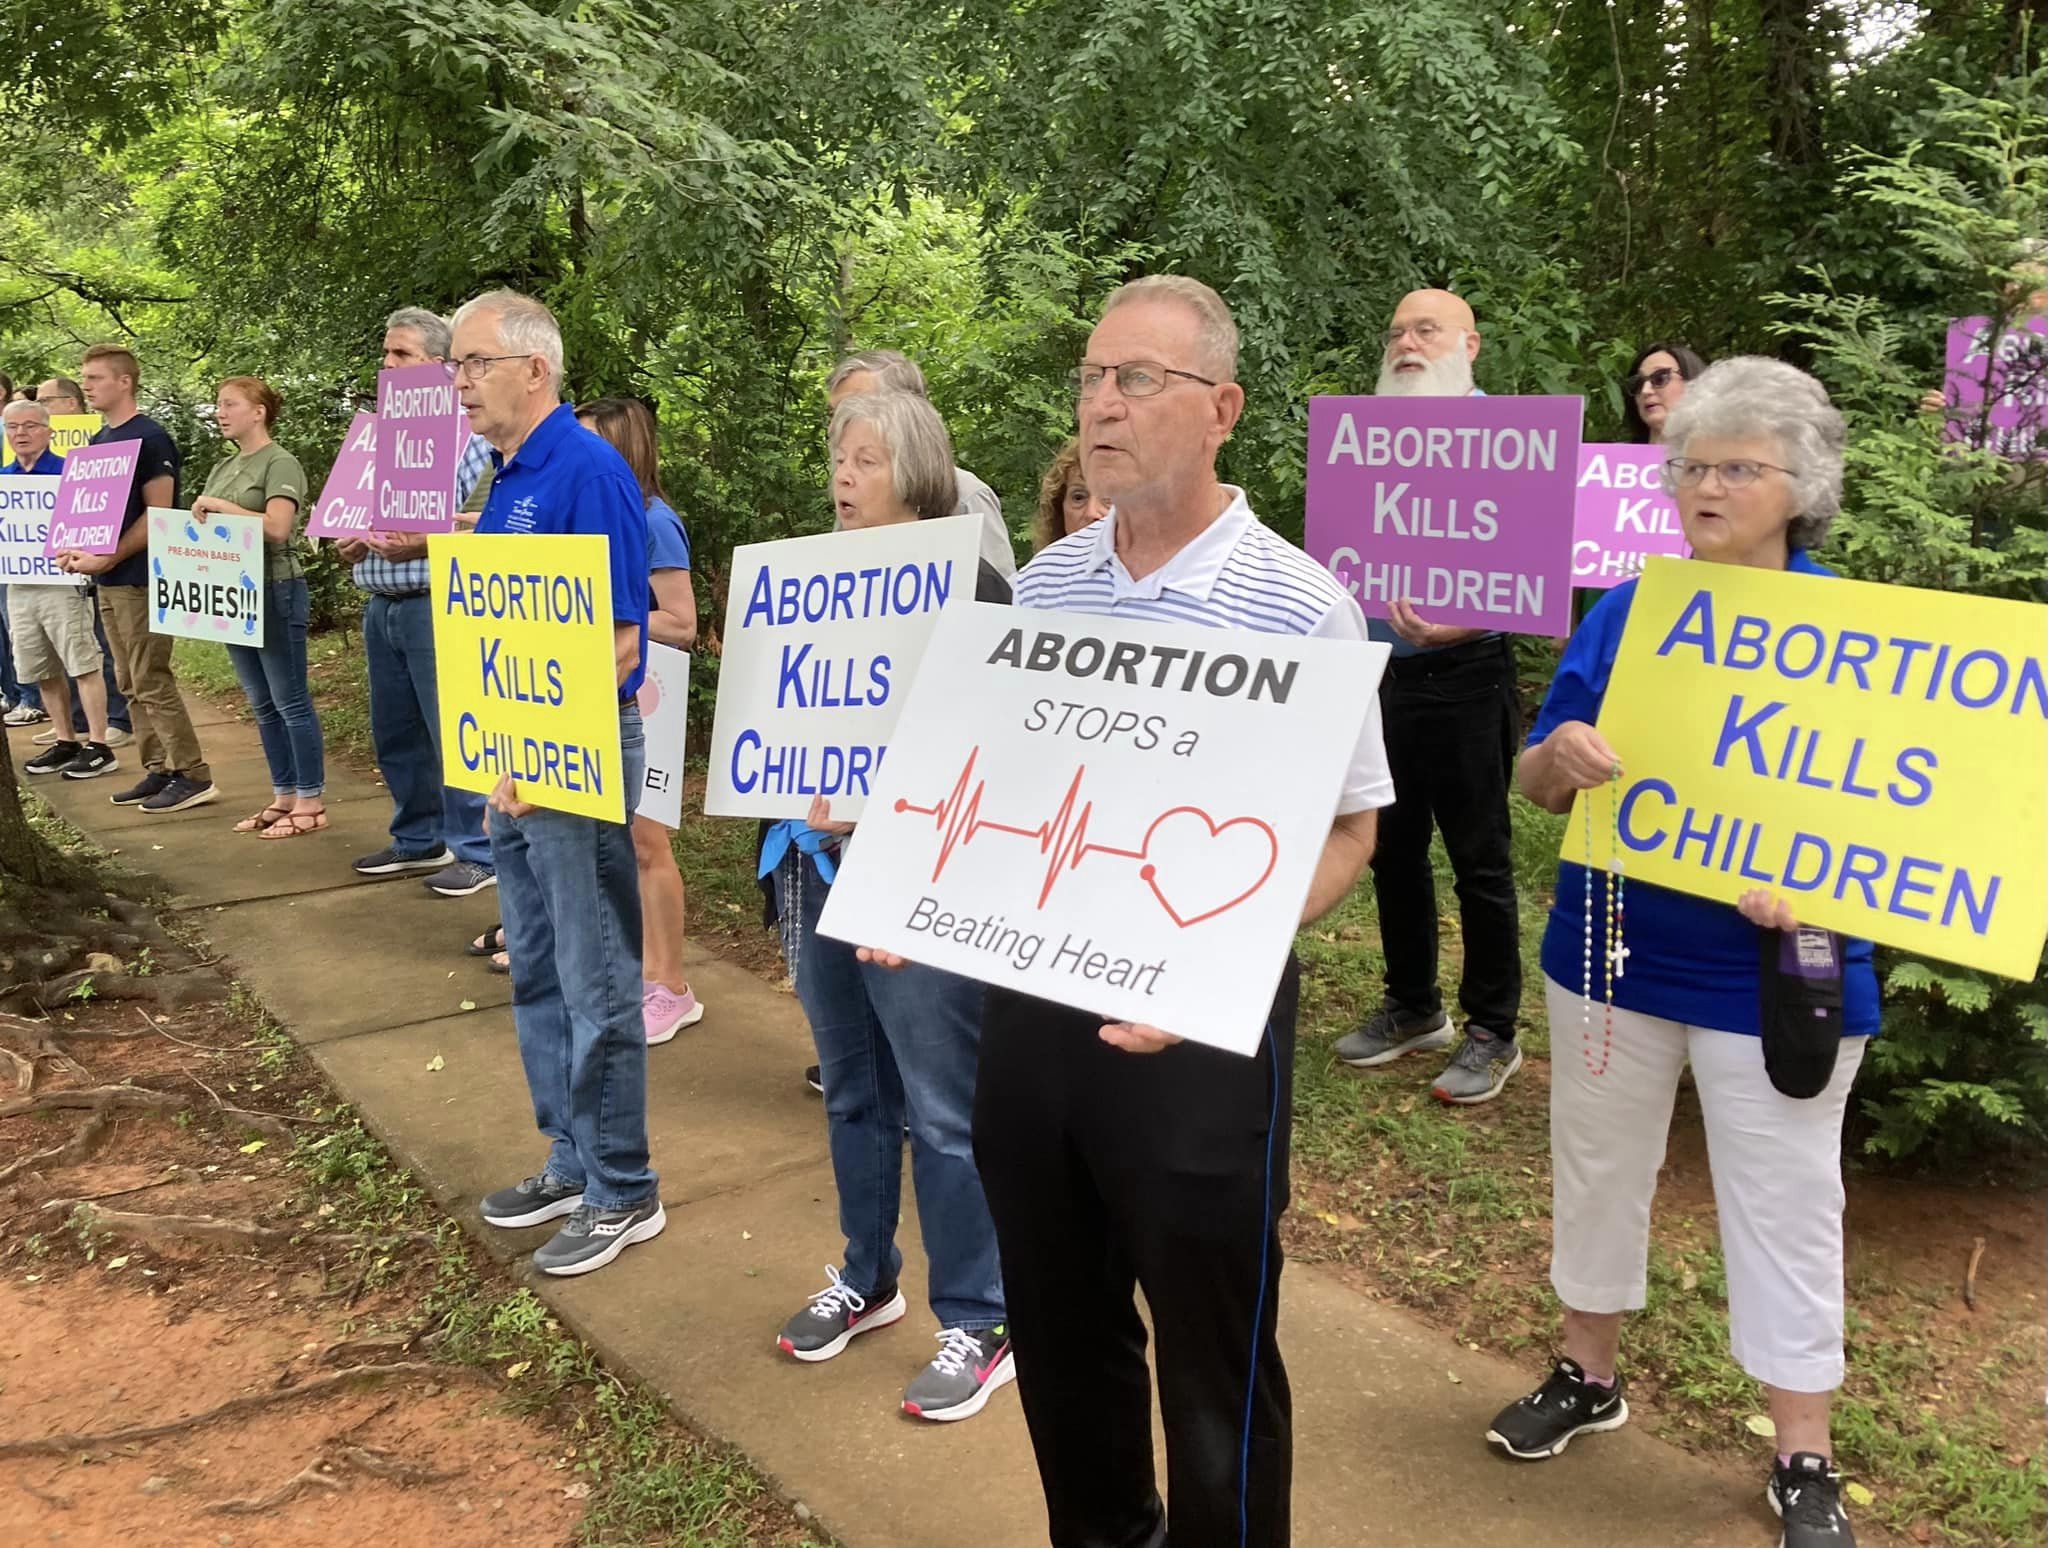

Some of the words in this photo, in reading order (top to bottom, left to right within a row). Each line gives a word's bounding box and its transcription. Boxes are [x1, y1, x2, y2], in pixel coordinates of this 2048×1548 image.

[382, 381, 453, 420] ABORTION
[66, 456, 131, 482] ABORTION
[394, 429, 435, 469] KILLS
[1326, 412, 1557, 472] ABORTION
[71, 488, 108, 514] KILLS
[322, 497, 373, 530] CHIL
[379, 479, 447, 521] CHILDREN
[1373, 481, 1499, 542] KILLS
[53, 522, 114, 548] CHILDREN
[168, 546, 208, 558] PRE-BORN
[211, 551, 241, 562] BABIES
[1, 556, 73, 576] ILDRE
[446, 556, 595, 626] ABORTION
[742, 559, 953, 629] ABORTION
[1328, 546, 1545, 617] CHILDREN
[158, 578, 257, 621] BABIES!!!
[479, 636, 564, 707] KILLS
[776, 642, 892, 709] KILLS
[986, 627, 1300, 705] ABORTION
[1655, 588, 2048, 720] ABORTION
[458, 712, 603, 796] CHILDREN
[1023, 698, 1167, 751] STOPS
[1172, 729, 1200, 757] a
[1711, 693, 1939, 807] KILLS
[1616, 778, 2003, 936] CHILDREN
[905, 895, 1046, 971] Beating
[1049, 932, 1167, 996] Heart
